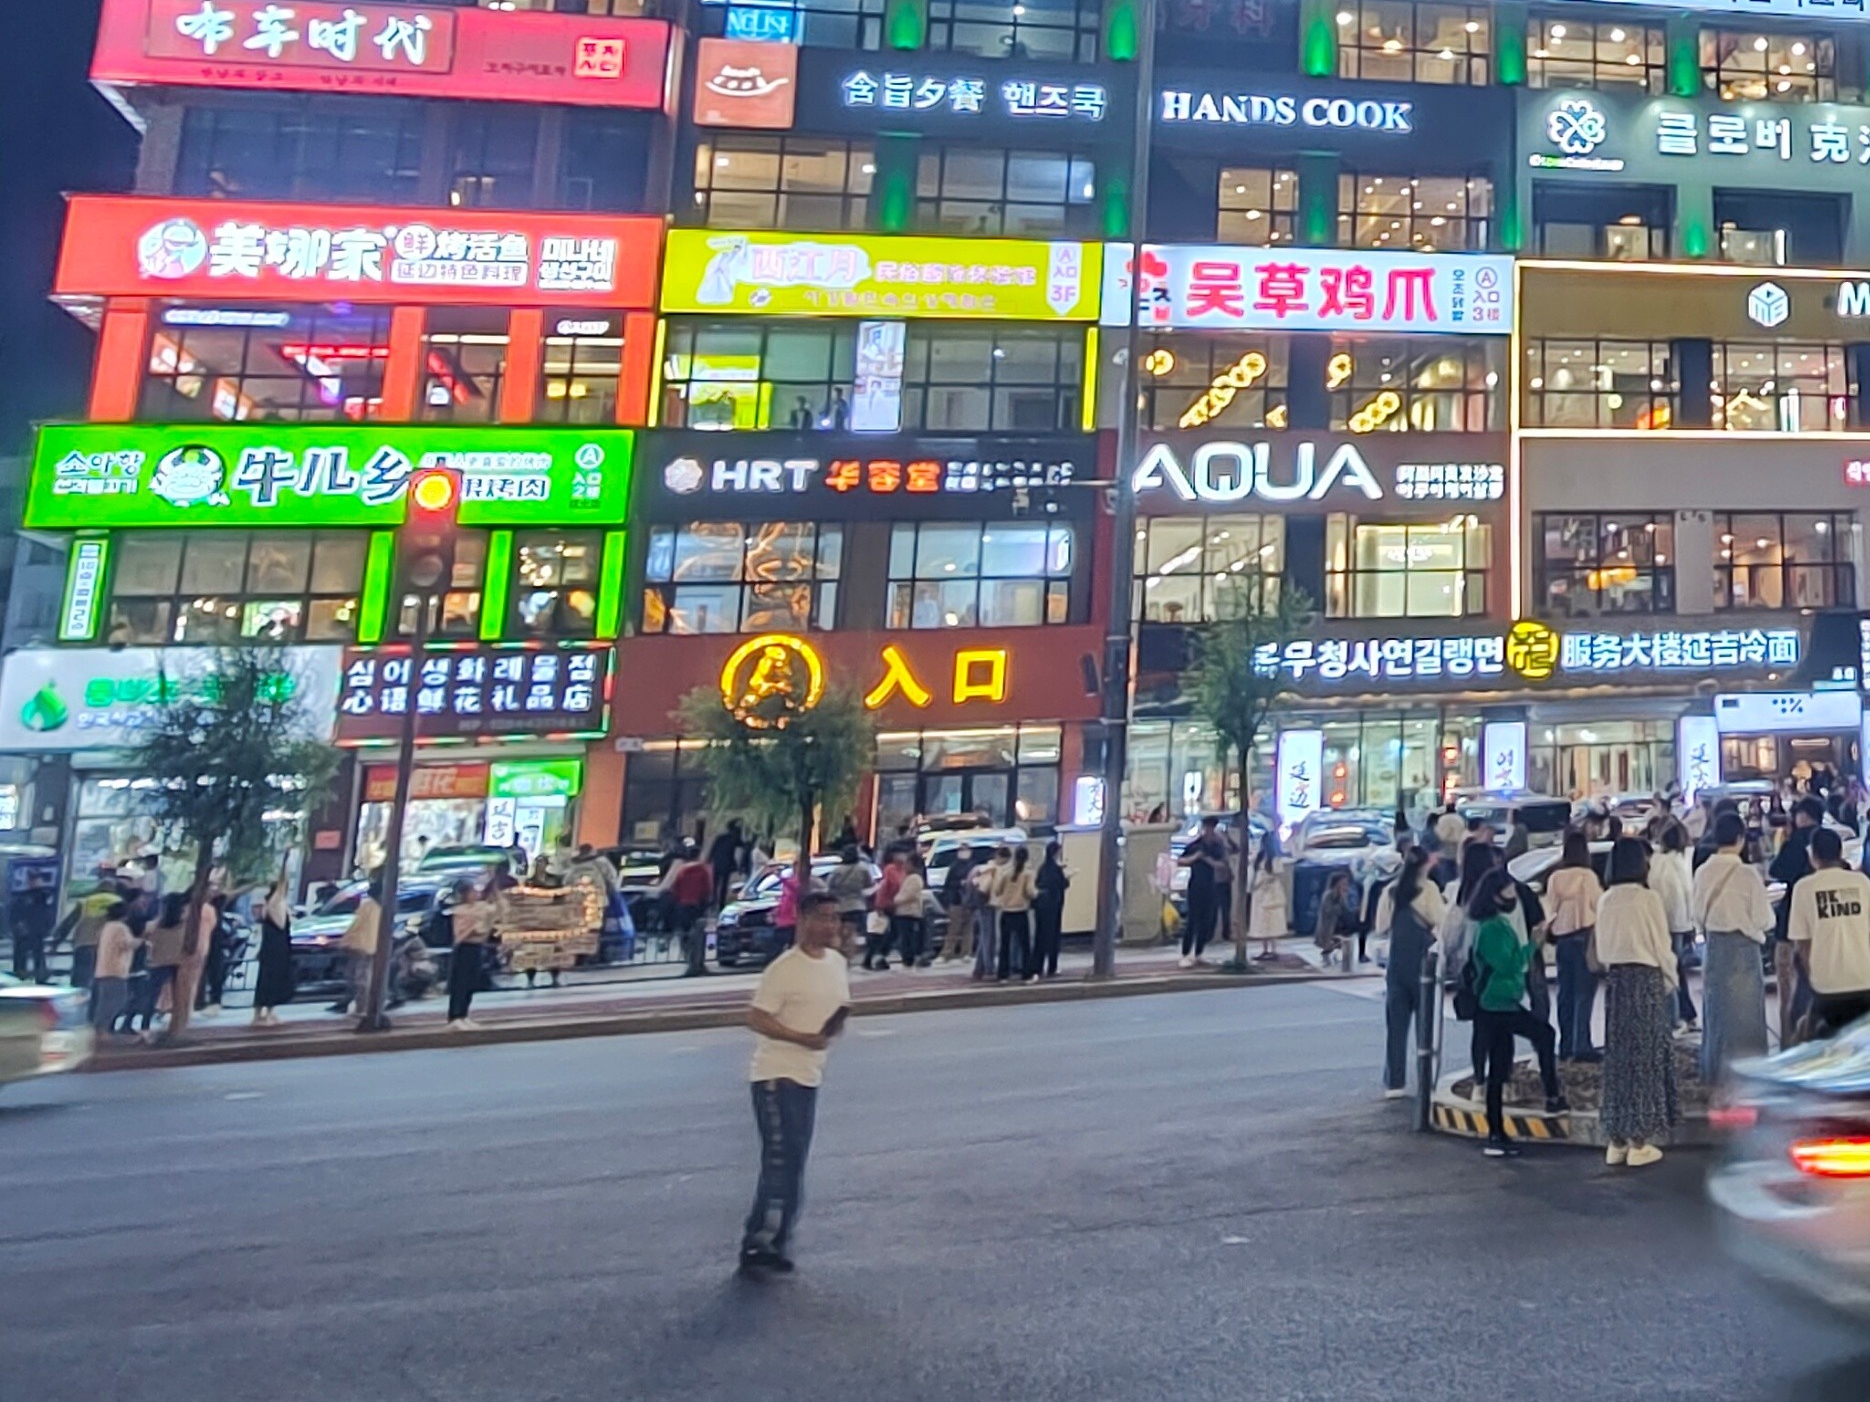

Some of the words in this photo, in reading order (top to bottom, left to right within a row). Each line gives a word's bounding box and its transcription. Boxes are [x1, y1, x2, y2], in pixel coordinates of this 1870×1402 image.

[1002, 81, 1107, 122] 핸즈쿡
[1161, 91, 1297, 127] HANDS
[1302, 98, 1413, 133] COOK
[1656, 112, 1793, 160] 클로버
[210, 223, 385, 282] 美娜家
[1050, 285, 1077, 304] 3F
[1186, 261, 1440, 323] 吴草鸡爪
[1473, 290, 1501, 304] 入口
[230, 445, 412, 505] 牛儿乡
[712, 458, 819, 493] HRT
[825, 459, 941, 493] 华容堂
[1132, 442, 1384, 501] AQUA
[1561, 629, 1799, 669] 服务大楼延吉冷面
[864, 644, 1009, 709] 入口
[1816, 902, 1862, 922] KIND
